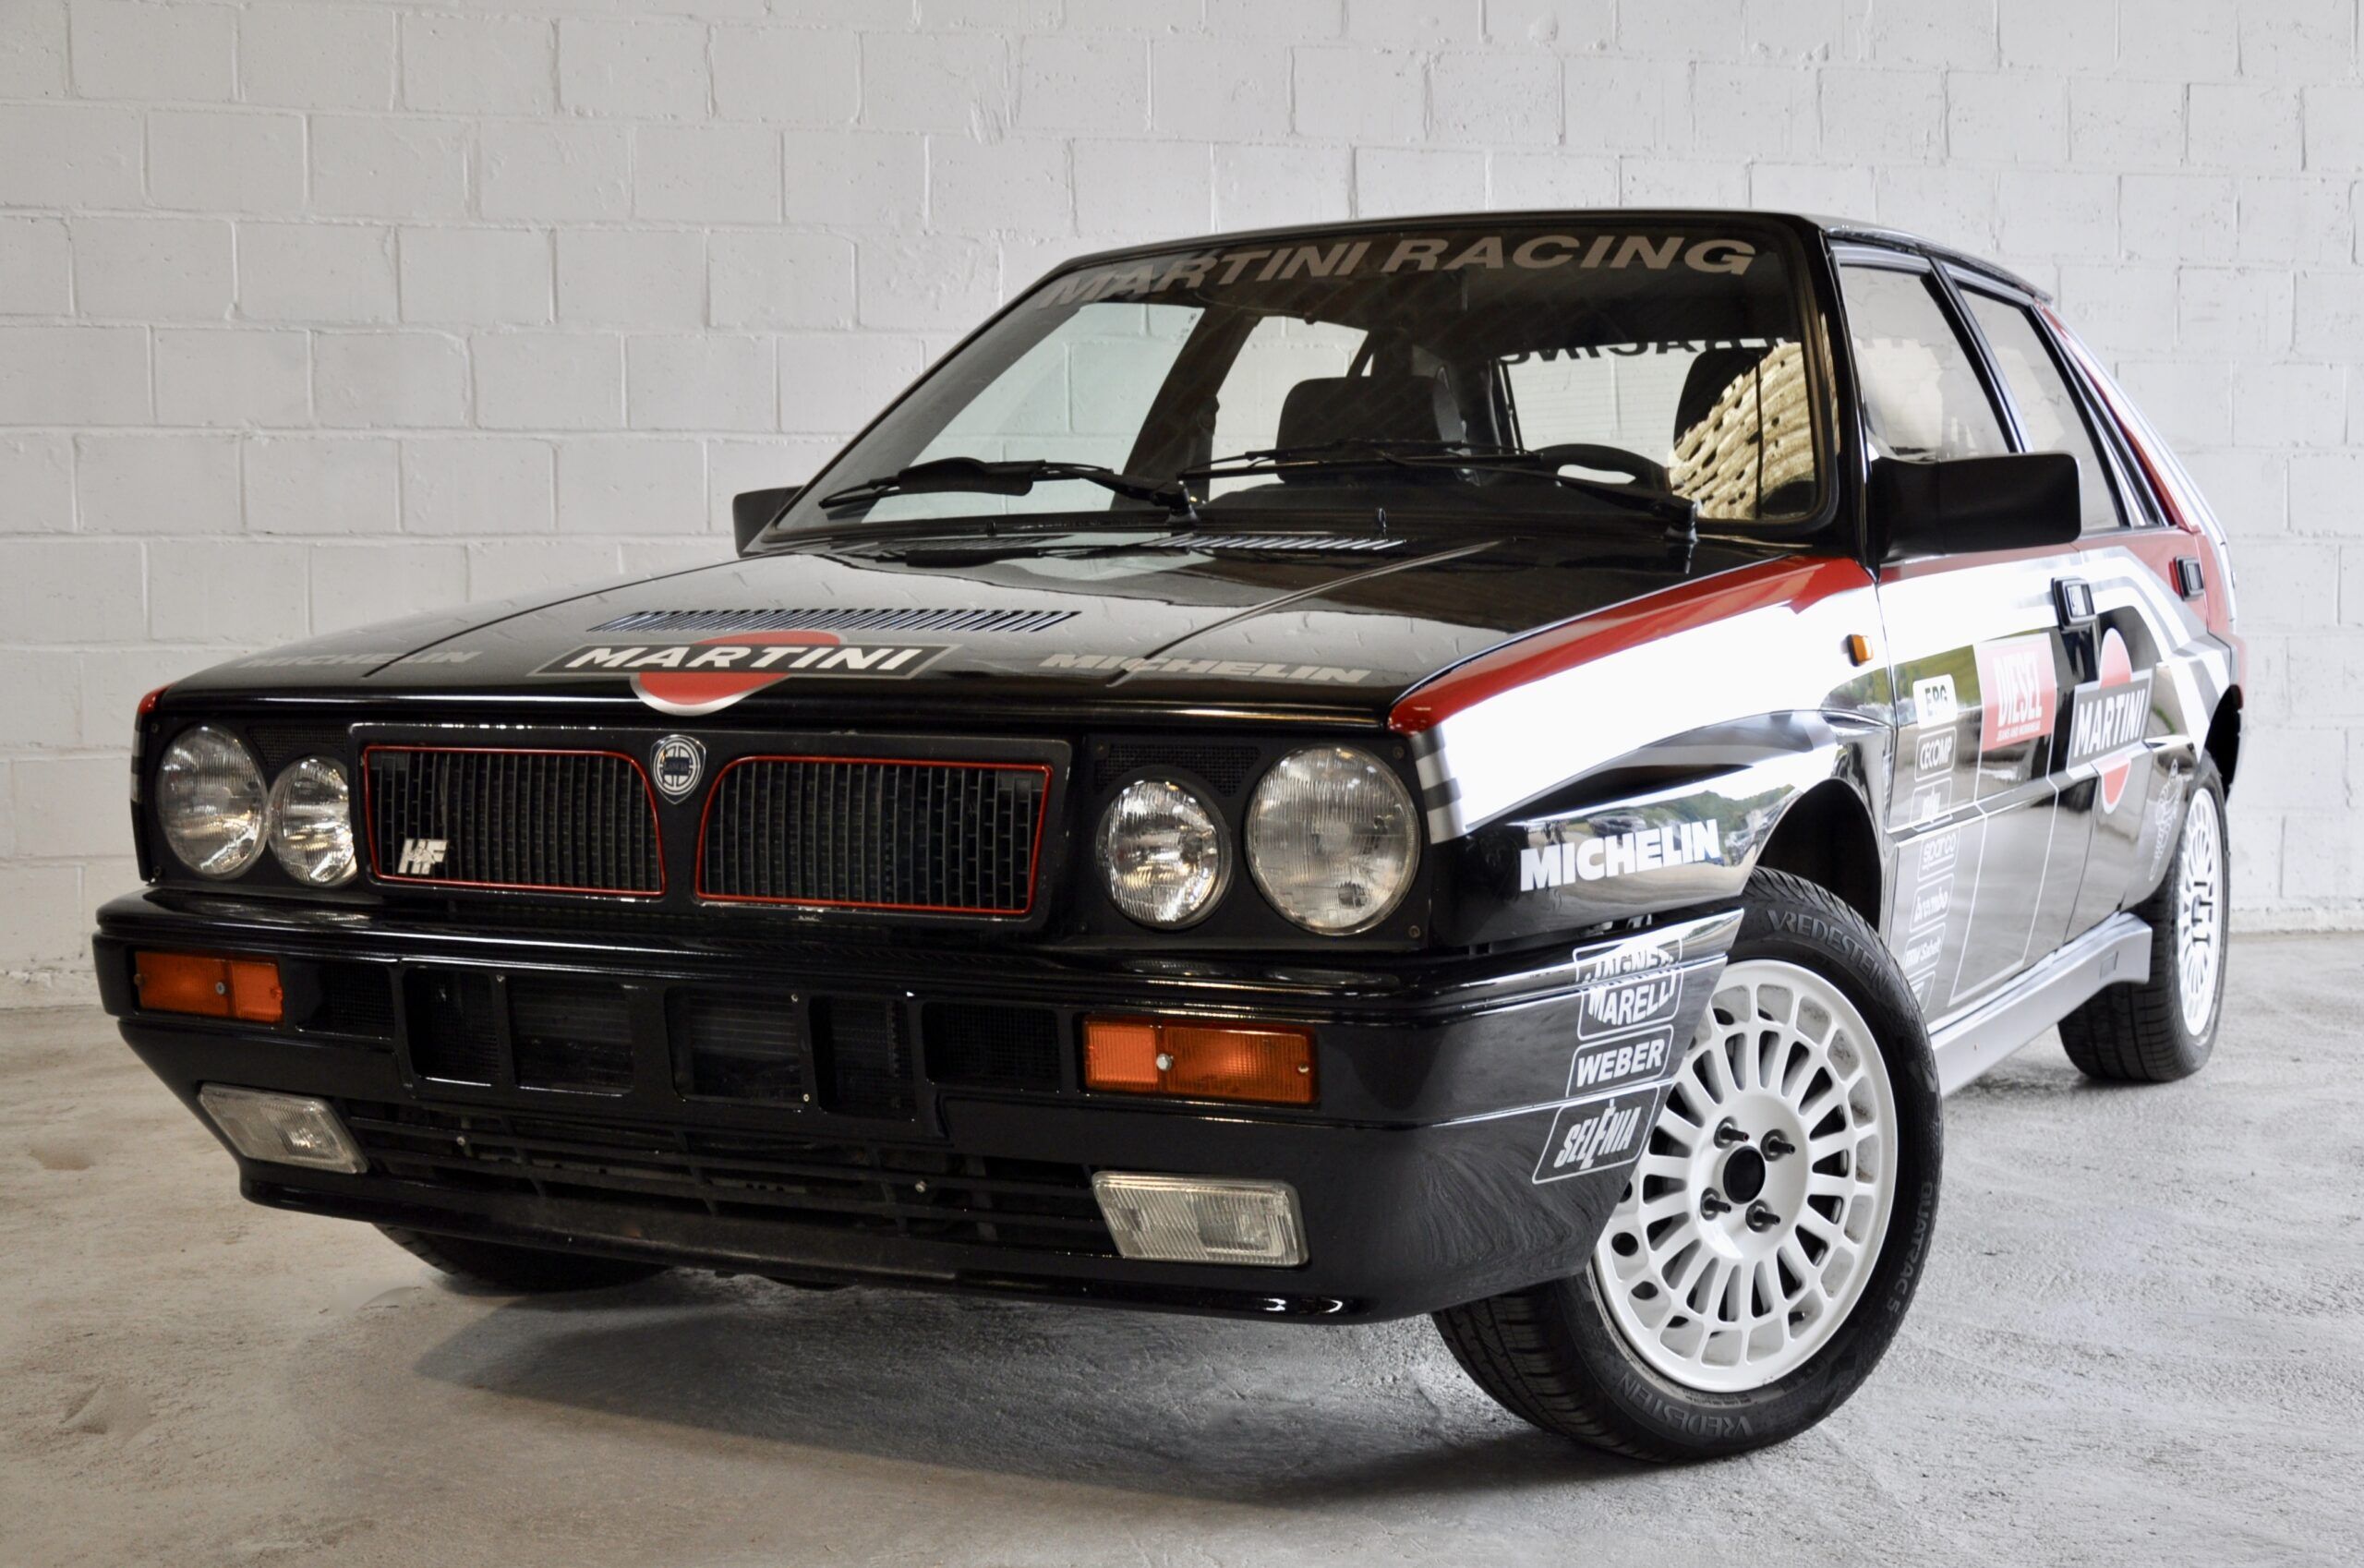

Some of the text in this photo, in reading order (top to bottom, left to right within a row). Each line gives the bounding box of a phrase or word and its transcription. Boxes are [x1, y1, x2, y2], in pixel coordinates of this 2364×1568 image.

[1036, 235, 1756, 310] MARTINI RACING
[565, 646, 923, 670] MARTINI
[1039, 654, 1372, 683] MICHELIN
[1993, 650, 2044, 727] DIESEL
[2074, 689, 2147, 757] MARTINI
[397, 838, 449, 875] HF
[1520, 818, 1722, 892] MICHELIN
[1767, 909, 1889, 988] VREDESTEIN
[1587, 970, 1677, 1026] MARELLI
[1576, 1039, 1666, 1088] WEBER
[1886, 1180, 1934, 1315] QUATRAC 5
[1620, 1372, 1755, 1439] VREDESTEIN
